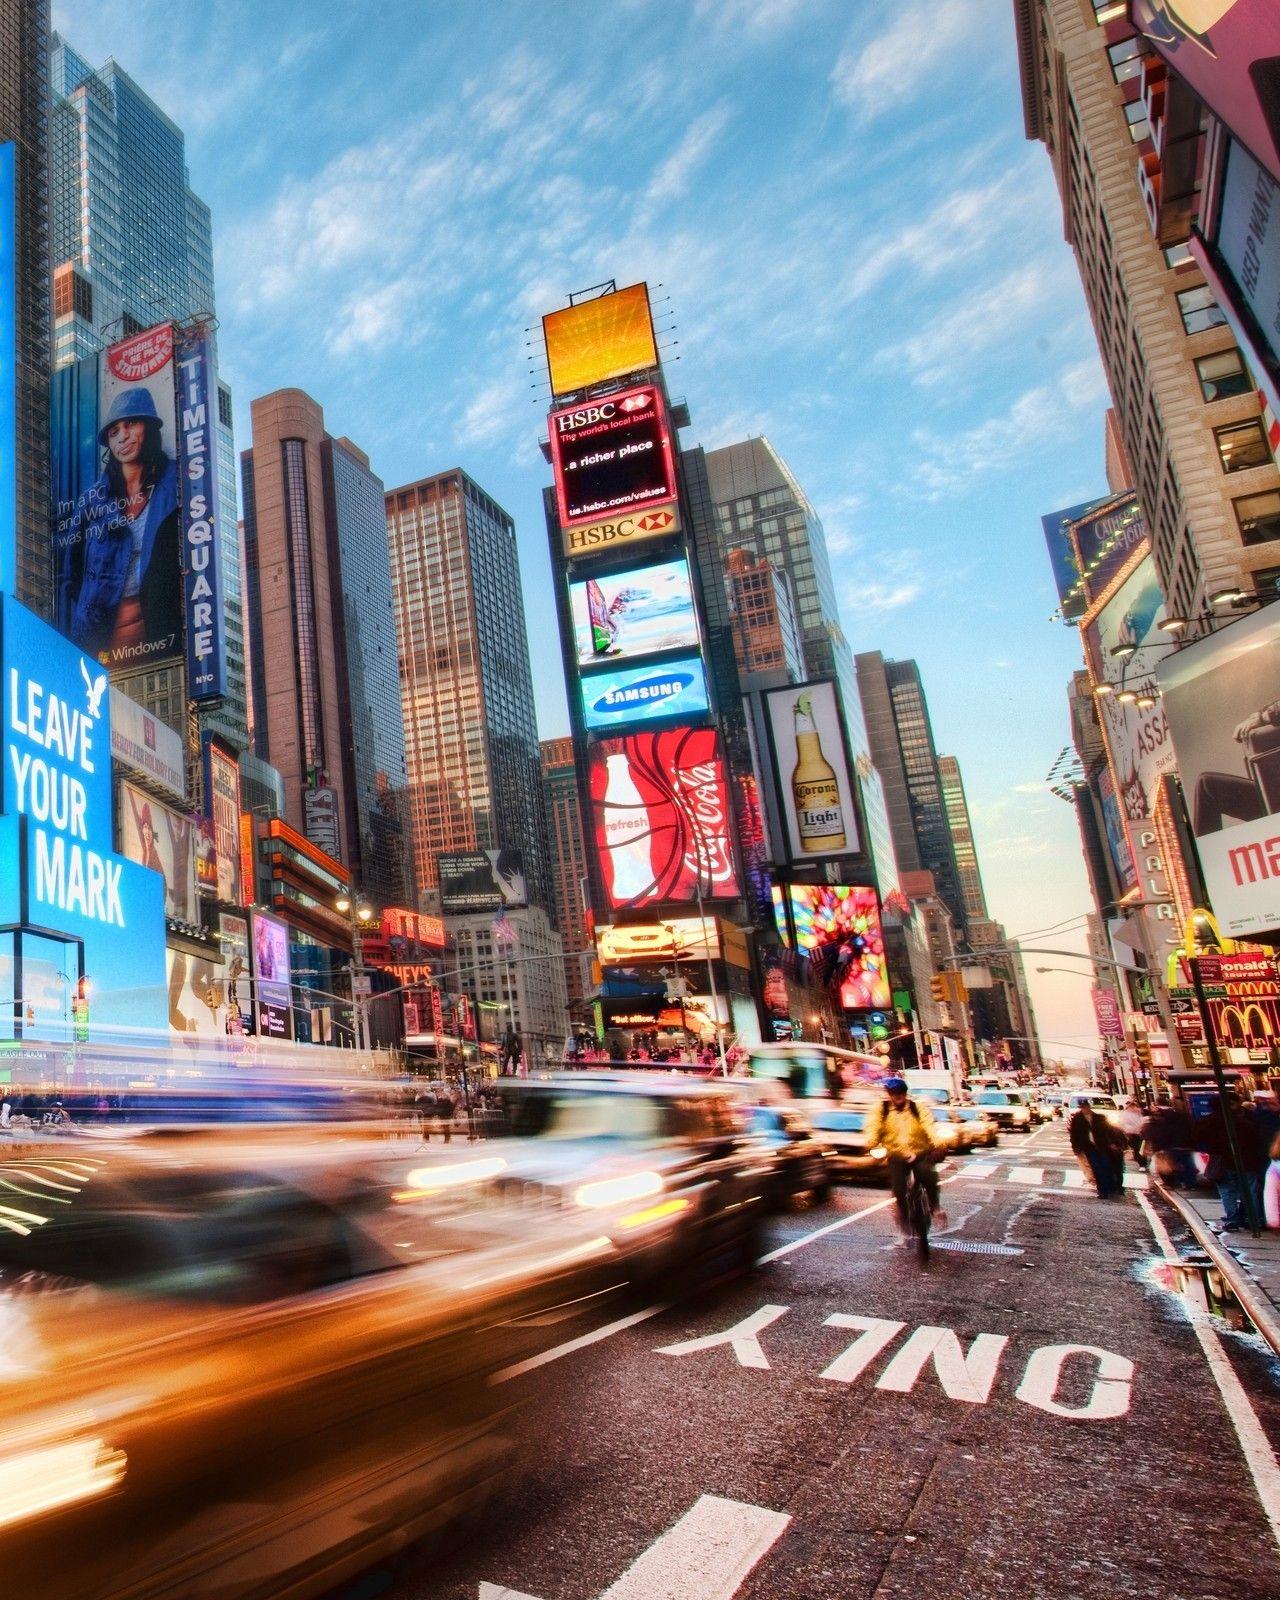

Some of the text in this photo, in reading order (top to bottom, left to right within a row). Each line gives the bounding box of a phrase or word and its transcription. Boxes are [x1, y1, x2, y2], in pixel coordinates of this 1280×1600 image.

[179, 354, 207, 481] TIMES
[557, 402, 617, 433] HSBC
[560, 410, 656, 443] The world's local bank
[580, 450, 616, 467] richer
[619, 440, 654, 459] place
[88, 485, 107, 503] PC
[569, 486, 667, 516] us.hsbc.com/values
[58, 484, 157, 532] and Windows 7
[59, 530, 83, 548] was
[85, 522, 106, 540] my
[569, 518, 636, 550] HSBC
[189, 492, 214, 658] SQUARE
[112, 637, 167, 662] Windows
[196, 674, 214, 684] NYC
[606, 681, 683, 705] SAMSUNG
[9, 667, 96, 774] LEAVE
[9, 744, 89, 842] YOUR
[796, 782, 837, 799] Corona
[606, 817, 649, 832] refresh
[803, 809, 839, 826] Light
[35, 829, 125, 928] MARK
[383, 965, 432, 988] HEY'S
[1221, 960, 1277, 971] onald's
[0, 1050, 27, 1058] EAGLE
[652, 1303, 1136, 1419] ONLY
